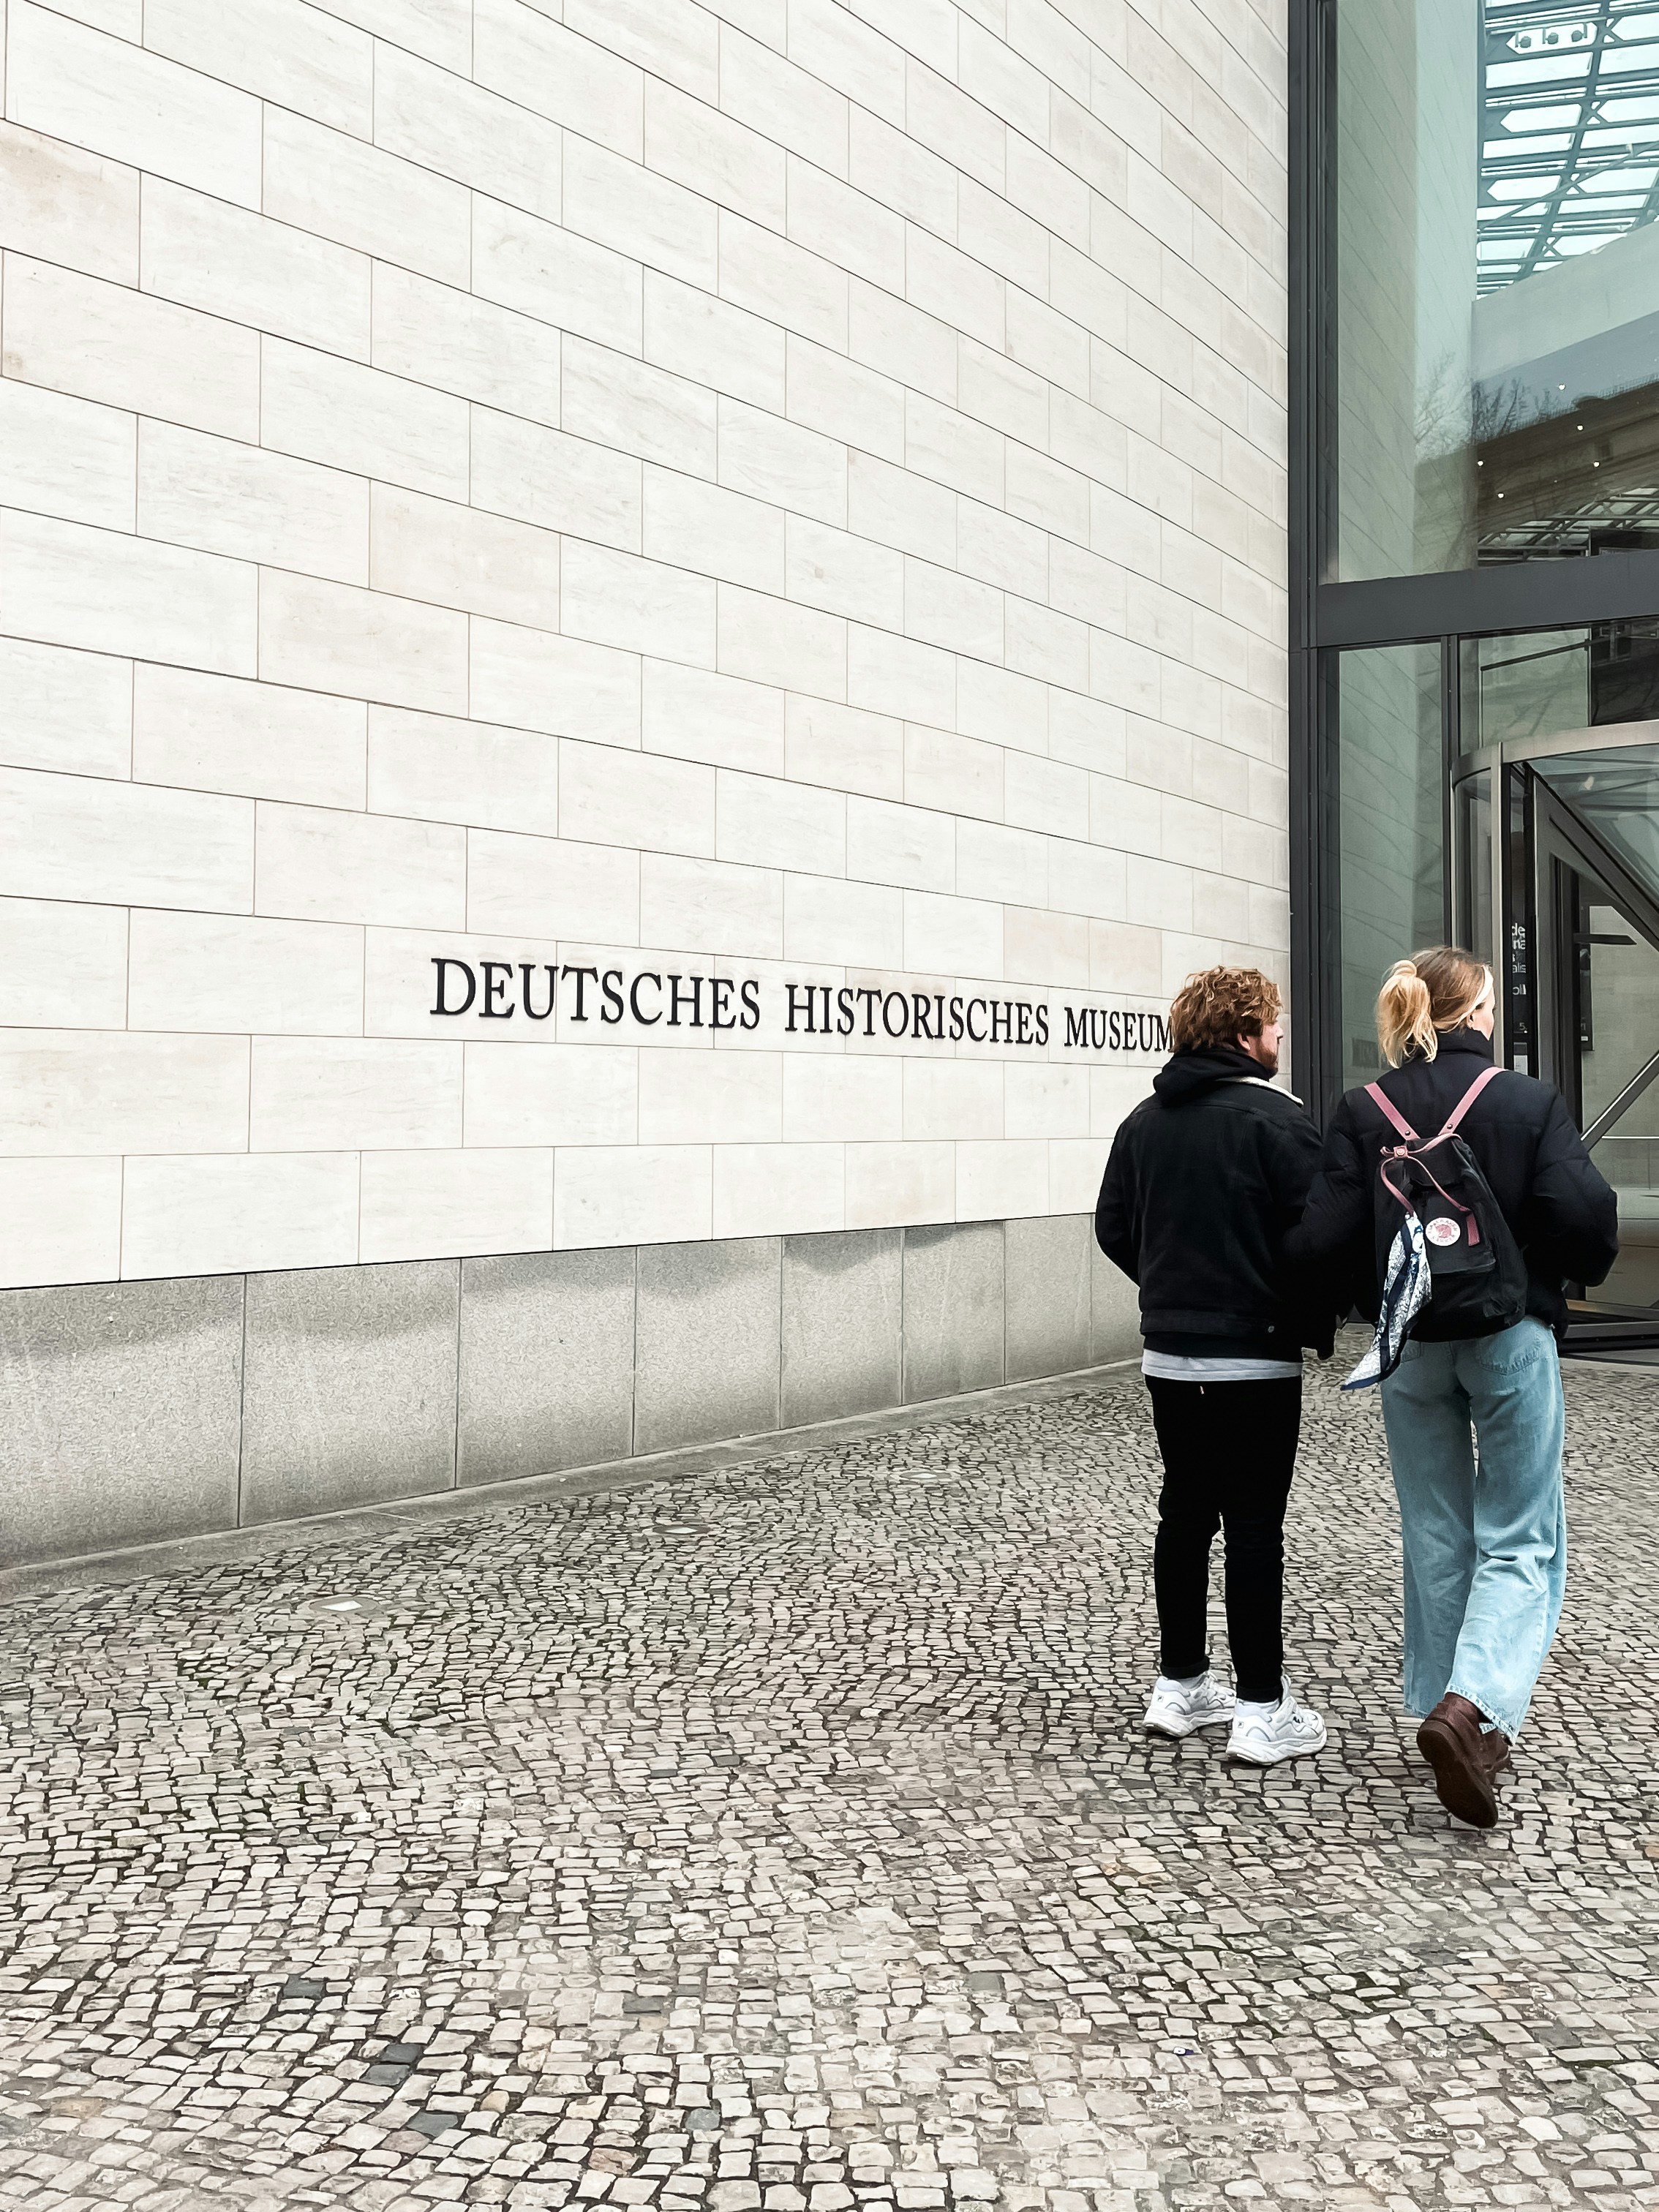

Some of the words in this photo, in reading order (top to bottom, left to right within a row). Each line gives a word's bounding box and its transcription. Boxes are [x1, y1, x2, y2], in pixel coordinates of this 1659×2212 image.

[430, 958, 760, 1030] DEUTSCHES
[785, 984, 1049, 1046] HISTORISCHES
[1064, 1007, 1174, 1053] MUSEUM
